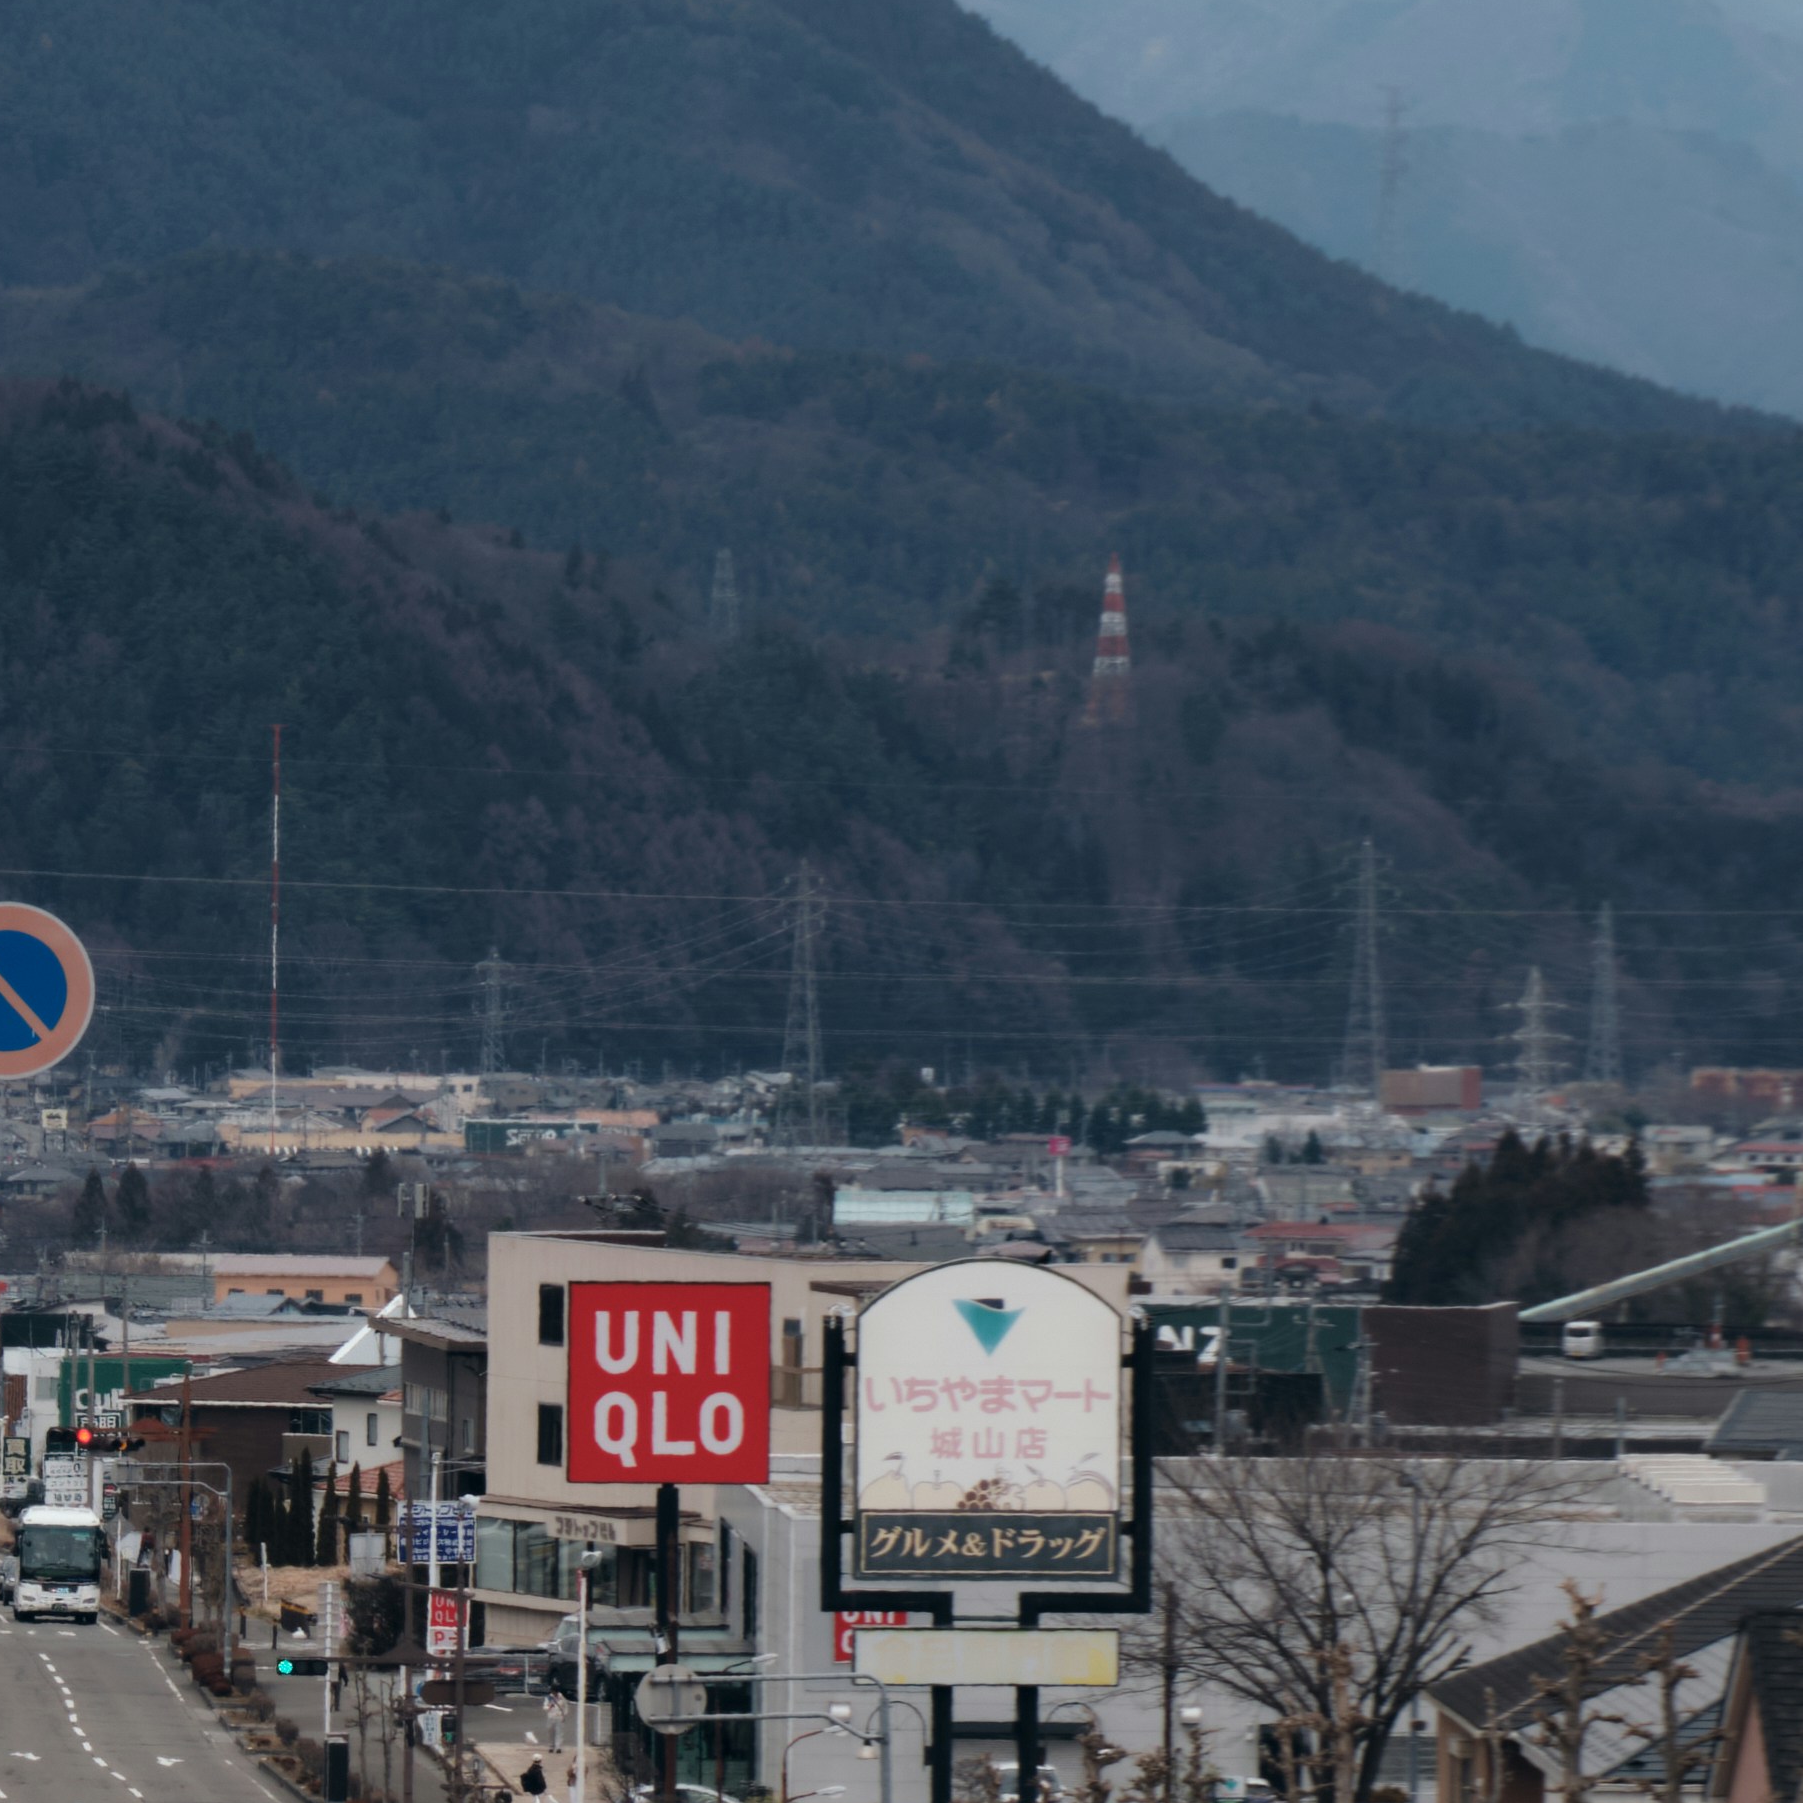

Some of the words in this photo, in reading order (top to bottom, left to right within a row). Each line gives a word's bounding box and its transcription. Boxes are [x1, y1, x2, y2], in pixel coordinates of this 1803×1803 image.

[595, 1311, 730, 1374] UNI
[865, 1375, 1112, 1414] いちやまマート
[595, 1392, 744, 1467] QLO
[930, 1427, 1049, 1460] 城山店
[870, 1525, 1107, 1560] グルメ&ドラッグ
